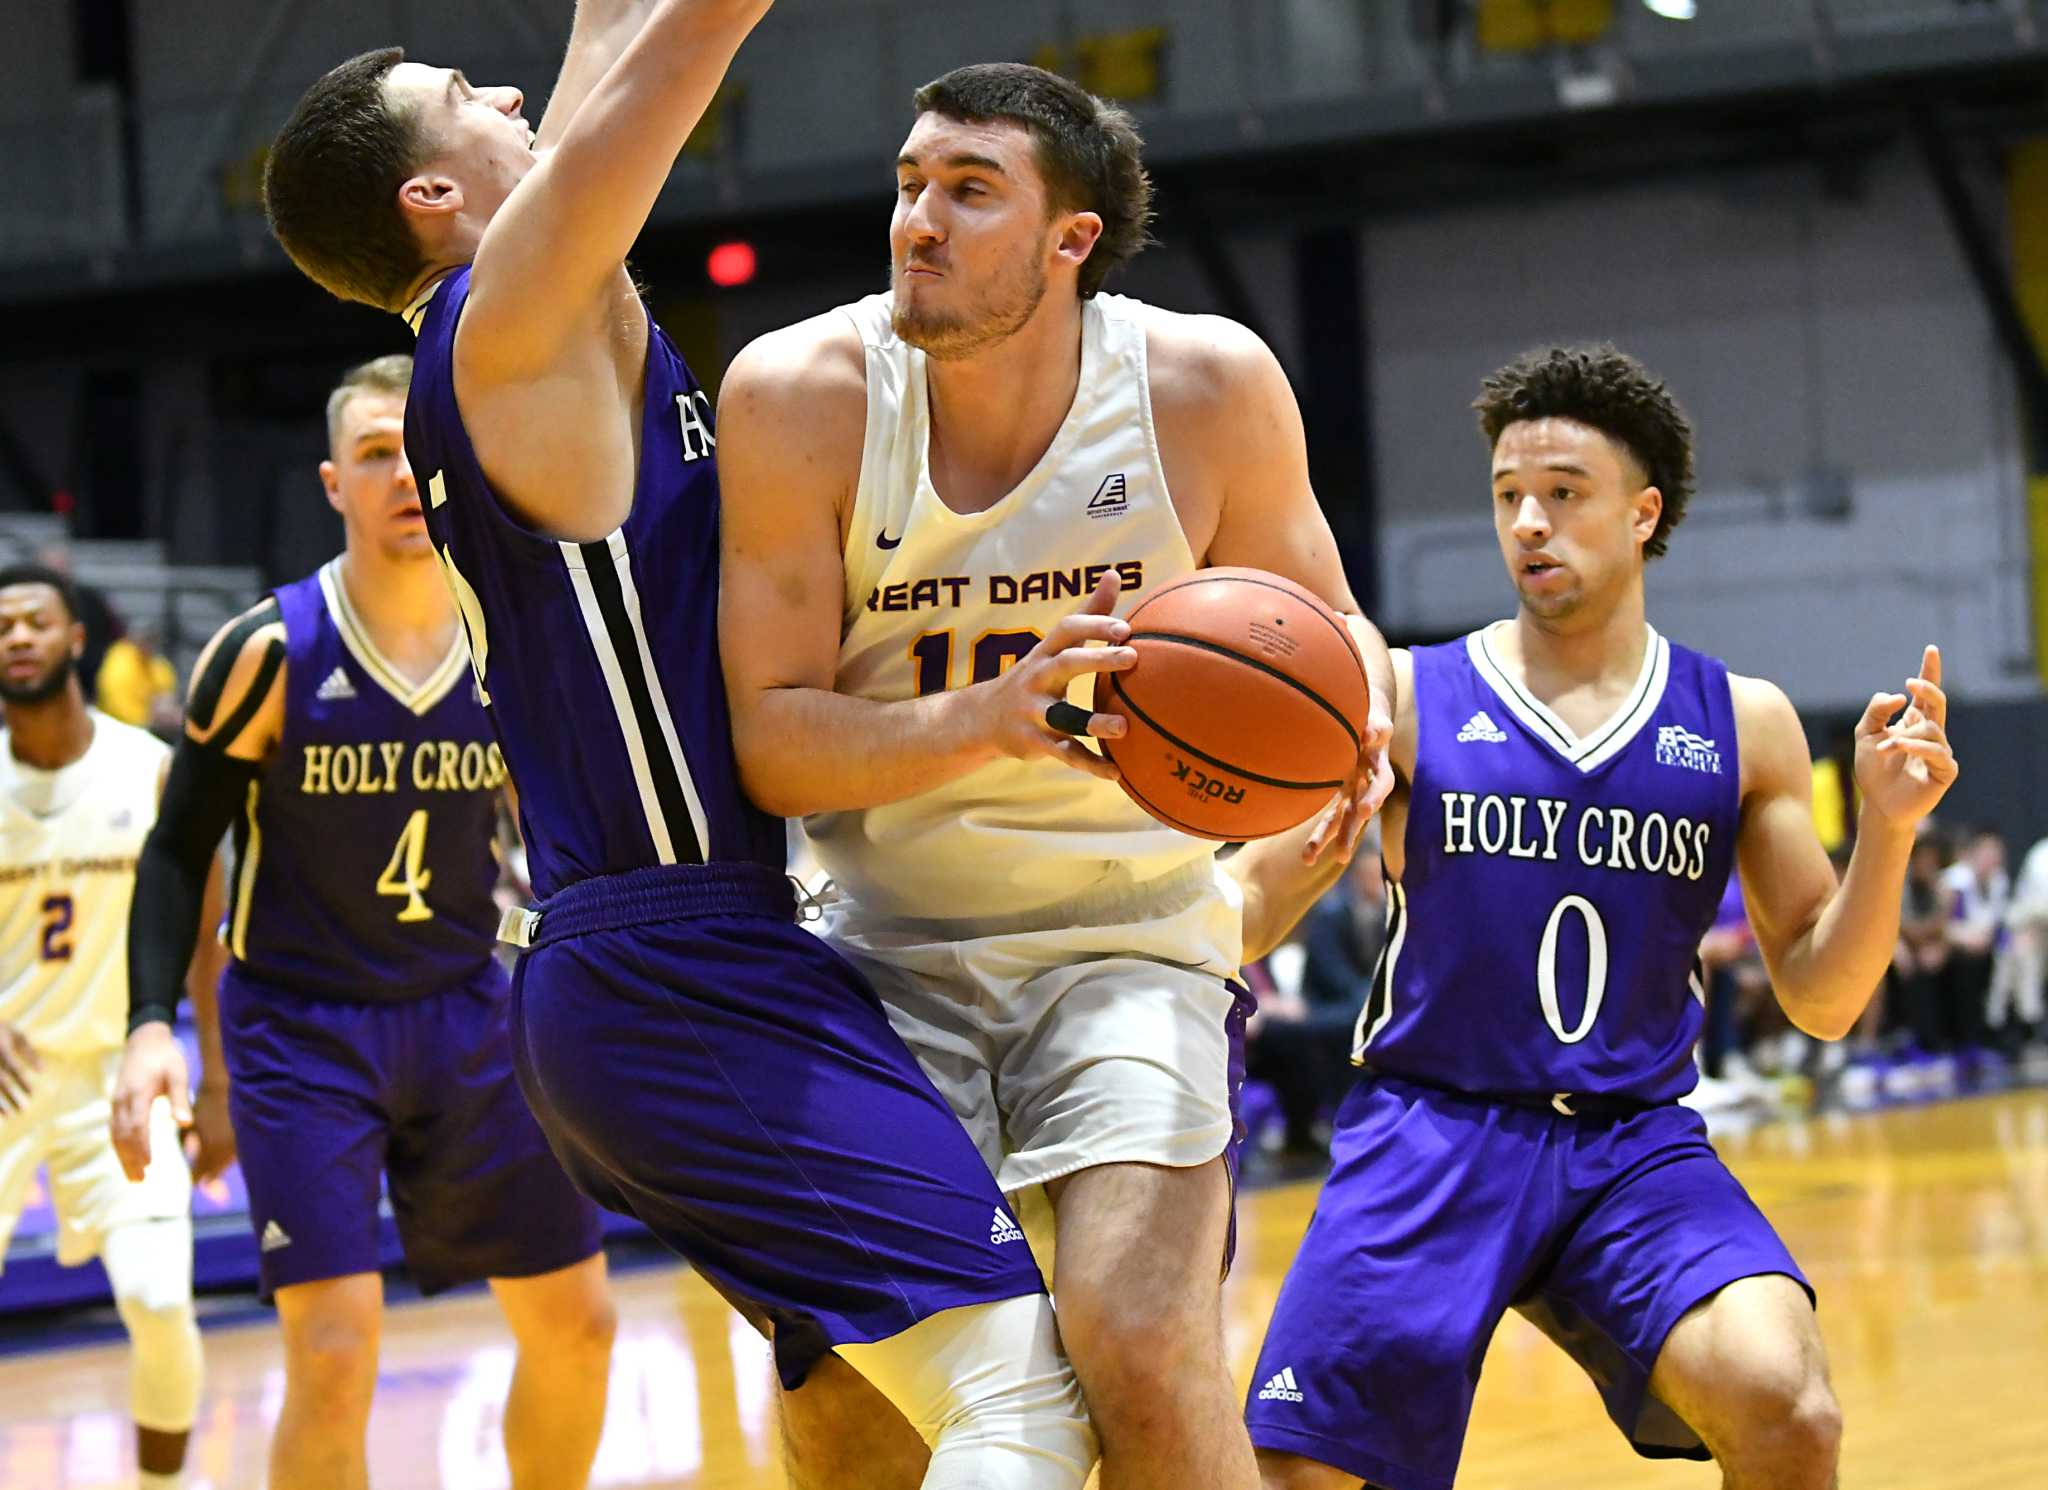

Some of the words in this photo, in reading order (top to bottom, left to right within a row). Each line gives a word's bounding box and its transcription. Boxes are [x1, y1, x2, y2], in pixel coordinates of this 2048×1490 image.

[1456, 729, 1507, 743] adidas
[1656, 751, 1722, 774] LEAGUE
[301, 741, 404, 794] HOLY
[1170, 759, 1246, 804] ROCK
[1441, 792, 1568, 860] HOLY
[1577, 806, 1710, 881] CROSS
[376, 808, 434, 922] 4
[41, 893, 74, 961] 2
[1537, 894, 1609, 1044] 0
[1258, 1385, 1304, 1403] adidas
